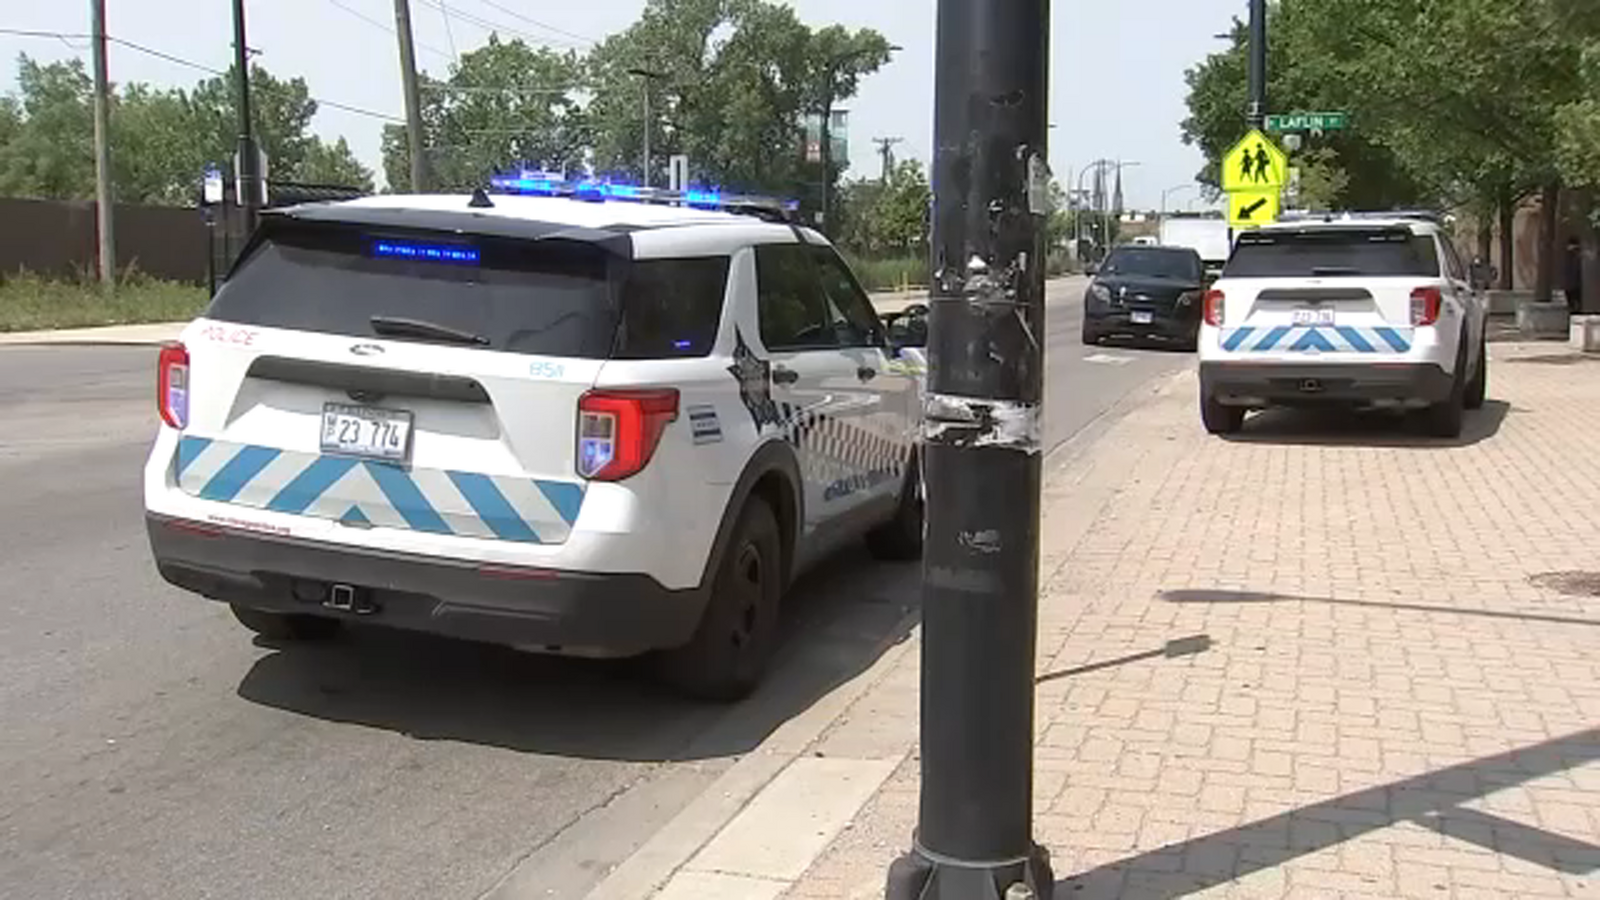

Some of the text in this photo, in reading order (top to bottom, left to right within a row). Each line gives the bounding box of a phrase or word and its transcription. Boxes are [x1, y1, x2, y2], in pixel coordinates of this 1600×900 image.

[1280, 117, 1323, 129] LAFLIN
[200, 326, 260, 346] POLICE
[339, 419, 361, 444] 23
